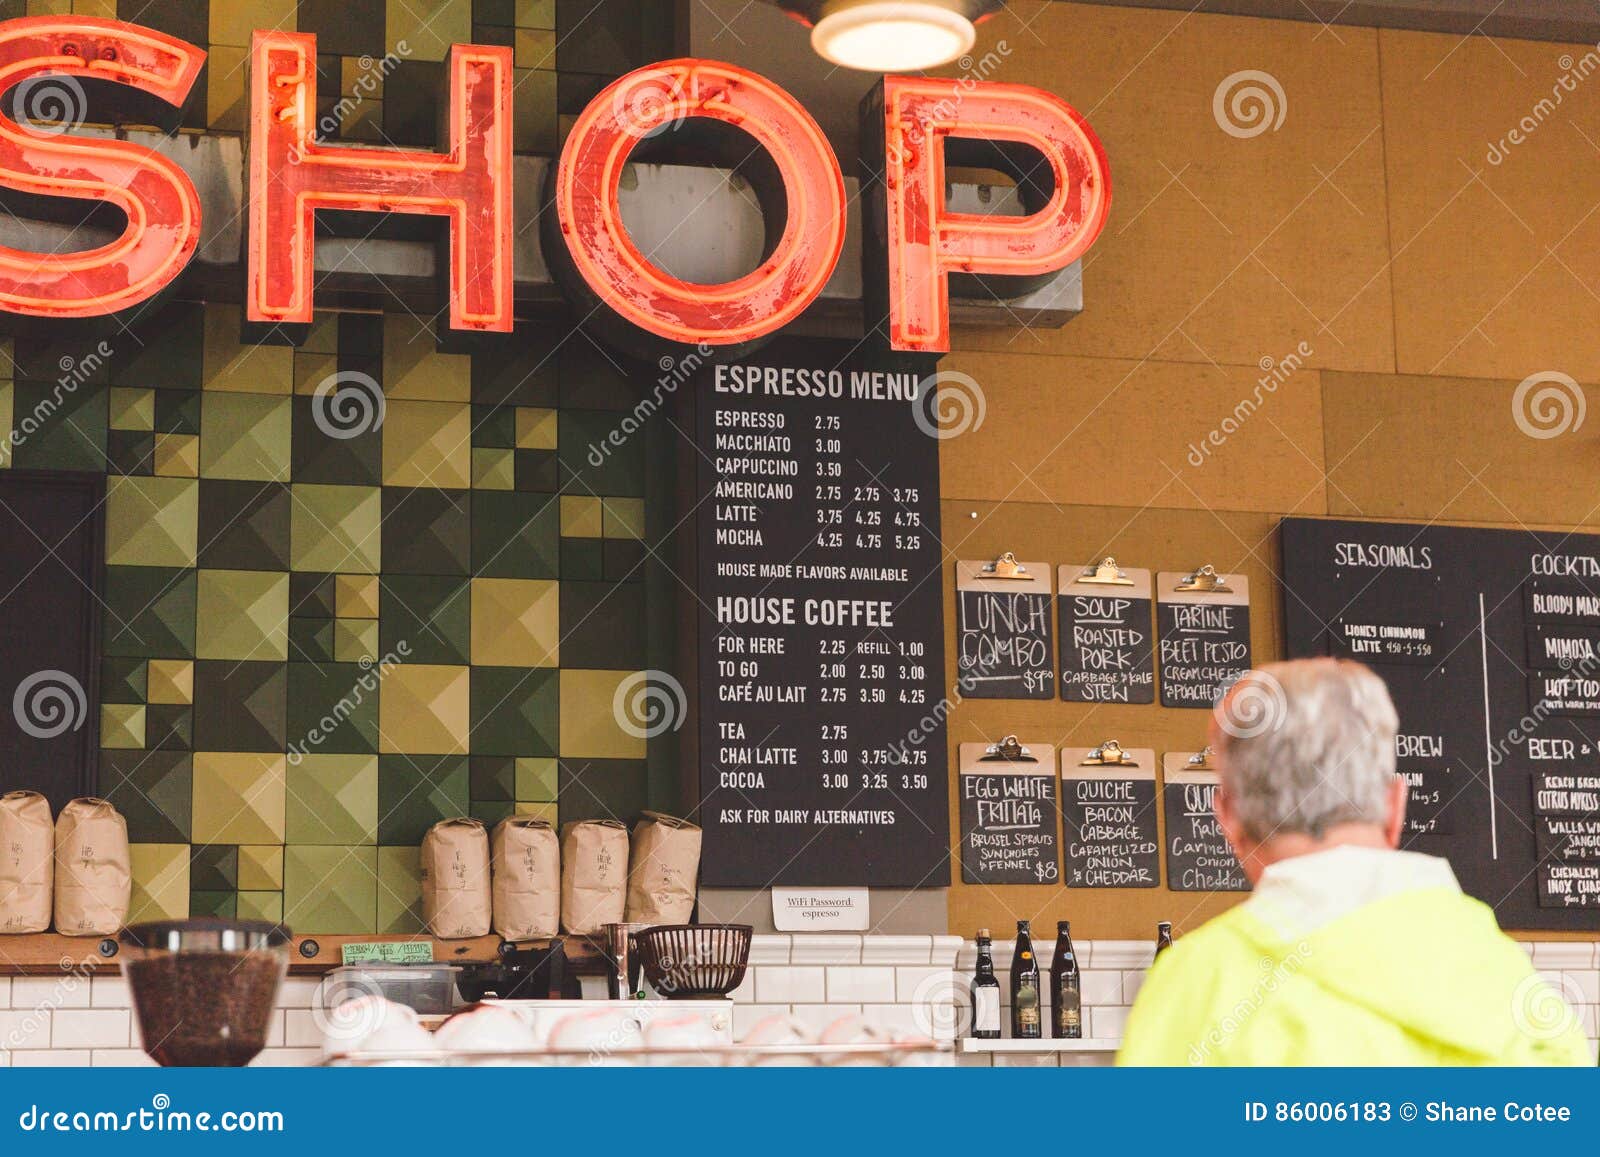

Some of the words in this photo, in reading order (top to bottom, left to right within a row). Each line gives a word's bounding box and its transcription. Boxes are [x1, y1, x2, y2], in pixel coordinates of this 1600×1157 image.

[0, 15, 1112, 353] SHOP
[715, 365, 842, 397] ESPRESSO
[851, 371, 919, 401] MENU
[716, 410, 784, 428] ESPRESSO
[816, 416, 840, 430] 2.75
[716, 434, 791, 452] MACCHIATO
[816, 439, 840, 453] 3.00
[716, 458, 798, 475] CAPPUCCINO
[816, 463, 841, 476] 3.50
[715, 482, 793, 499] AMERICANO
[816, 487, 841, 500] 2.75
[855, 488, 879, 501] 2.75
[894, 489, 919, 502] 3.75
[716, 505, 757, 522] LATTE
[817, 510, 842, 523] 3.75
[856, 511, 881, 525] 4.25
[894, 513, 920, 526] 4.75
[717, 529, 763, 546] MOCHA
[817, 534, 842, 547] 4.25
[856, 535, 881, 548] 4.75
[896, 536, 920, 549] 5.25
[1335, 543, 1432, 570] SEASONALS
[718, 563, 756, 576] HOUSE
[760, 564, 792, 578] MADE
[796, 565, 846, 579] FLAVORS
[850, 567, 908, 581] AVAILABLE
[717, 596, 795, 624] HOUSE
[805, 599, 893, 627] COFFEE
[960, 591, 1046, 636] LUNCH
[1074, 597, 1131, 619] SOUP
[1534, 594, 1573, 615] BLOODY
[1577, 595, 1600, 616] MAR
[1168, 605, 1234, 629] TARTINE
[1074, 626, 1143, 648] ROASTED
[1345, 625, 1376, 637] HONEY
[719, 637, 744, 653] FOR
[751, 638, 784, 654] HERE
[820, 640, 845, 654] 2.25
[857, 642, 890, 654] REFILL
[899, 642, 923, 656] 1.00
[963, 633, 1045, 667] COMBO
[1161, 638, 1199, 664] BEET
[1204, 642, 1247, 663] PESTO
[1352, 639, 1381, 653] LATTE
[1545, 637, 1594, 659] MIMOSA
[718, 661, 734, 677] TO
[740, 661, 757, 677] GO
[820, 664, 845, 678] 2.00
[860, 665, 884, 679] 2.50
[900, 666, 924, 680] 3.00
[1063, 671, 1119, 683] CABBAGE
[1129, 672, 1152, 686] KALE
[1165, 666, 1201, 680] CREAM
[719, 682, 752, 701] CAFÉ
[756, 686, 773, 702] AU
[778, 686, 806, 702] LAIT
[821, 688, 846, 702] 2.75
[860, 689, 885, 702] 3.50
[900, 690, 925, 703] 4.25
[1082, 683, 1128, 702] STEW
[1175, 684, 1221, 700] POACHED
[1545, 679, 1570, 696] HOT
[719, 723, 745, 739] TEA
[822, 726, 847, 739] 2.75
[1396, 734, 1442, 757] BREW
[1528, 738, 1574, 759] BEER
[1581, 744, 1590, 755] &
[720, 748, 751, 764] CHAI
[757, 748, 797, 764] LATTE
[822, 750, 847, 763] 3.00
[862, 751, 887, 764] 3.75
[901, 751, 926, 764] 4.75
[720, 772, 764, 788] COCOA
[823, 775, 848, 788] 3.00
[862, 775, 887, 788] 3.25
[902, 775, 927, 789] 3.50
[966, 776, 999, 799] EGG
[1003, 777, 1055, 799] WHITE
[1077, 781, 1135, 800] QUICHE
[1538, 790, 1568, 809] CITRUS
[720, 810, 741, 823] ASK
[747, 810, 769, 823] FOR
[775, 810, 808, 824] DAIRY
[814, 811, 894, 824] ALTERNATIVES
[978, 799, 1041, 826] FRITTATA
[1548, 821, 1585, 833] WALLA
[971, 833, 1010, 848] BRUSSEL
[1014, 834, 1053, 846] SPROUTS
[1070, 843, 1156, 857] CARAMELIZED
[1172, 837, 1233, 856] Carmeli
[989, 860, 1031, 870] FENNEL
[1035, 861, 1057, 882] $8
[1086, 868, 1152, 885] CHEDDAR
[1183, 868, 1245, 888] Cheddar
[788, 898, 807, 906] WiFi
[802, 910, 839, 919] espresso
